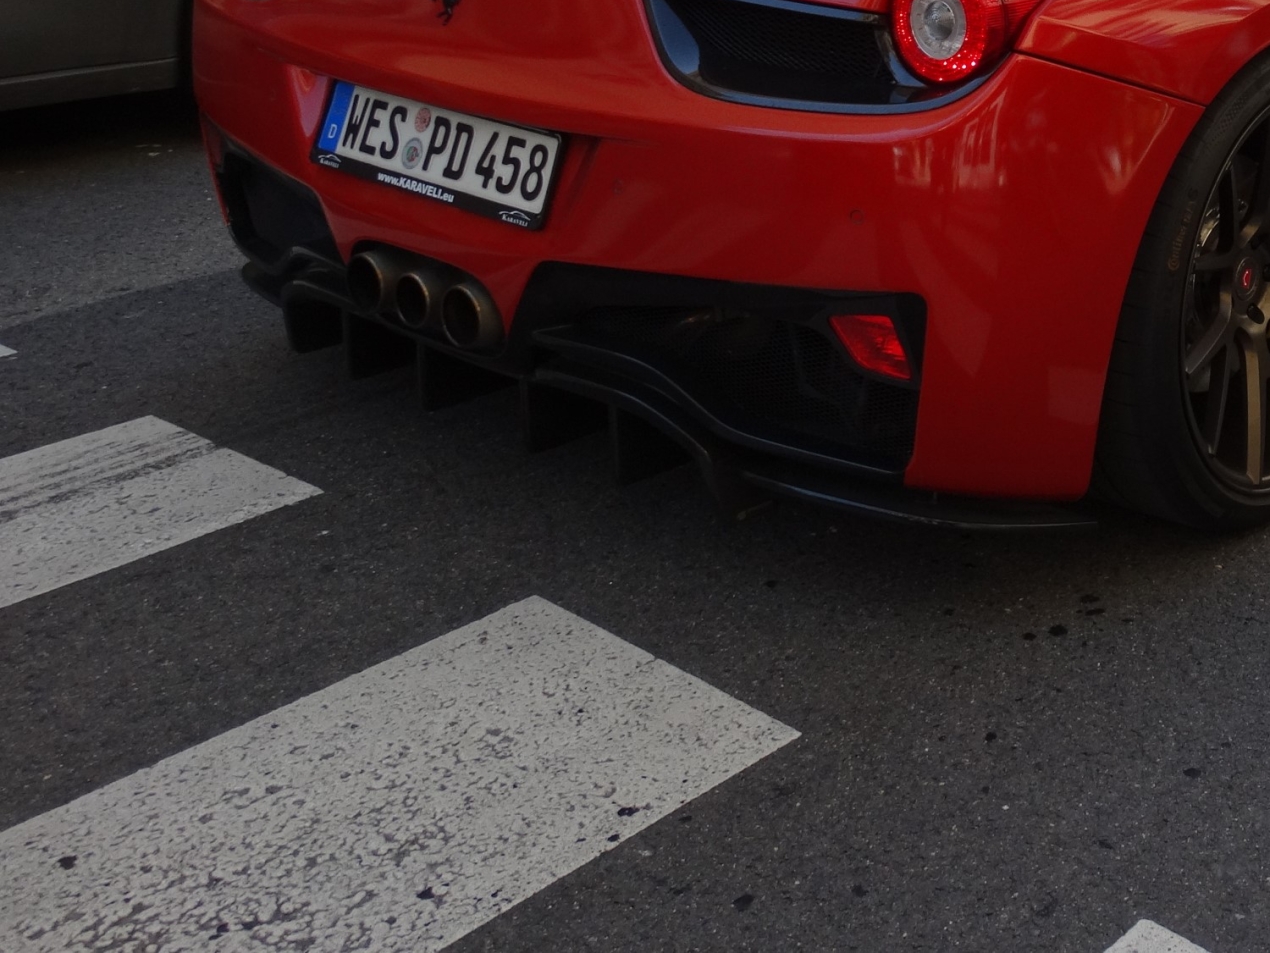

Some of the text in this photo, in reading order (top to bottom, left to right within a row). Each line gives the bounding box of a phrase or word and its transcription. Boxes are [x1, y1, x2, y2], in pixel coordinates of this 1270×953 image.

[327, 94, 549, 201] D WES PD 458
[377, 171, 455, 203] www.KARAVELI.eu
